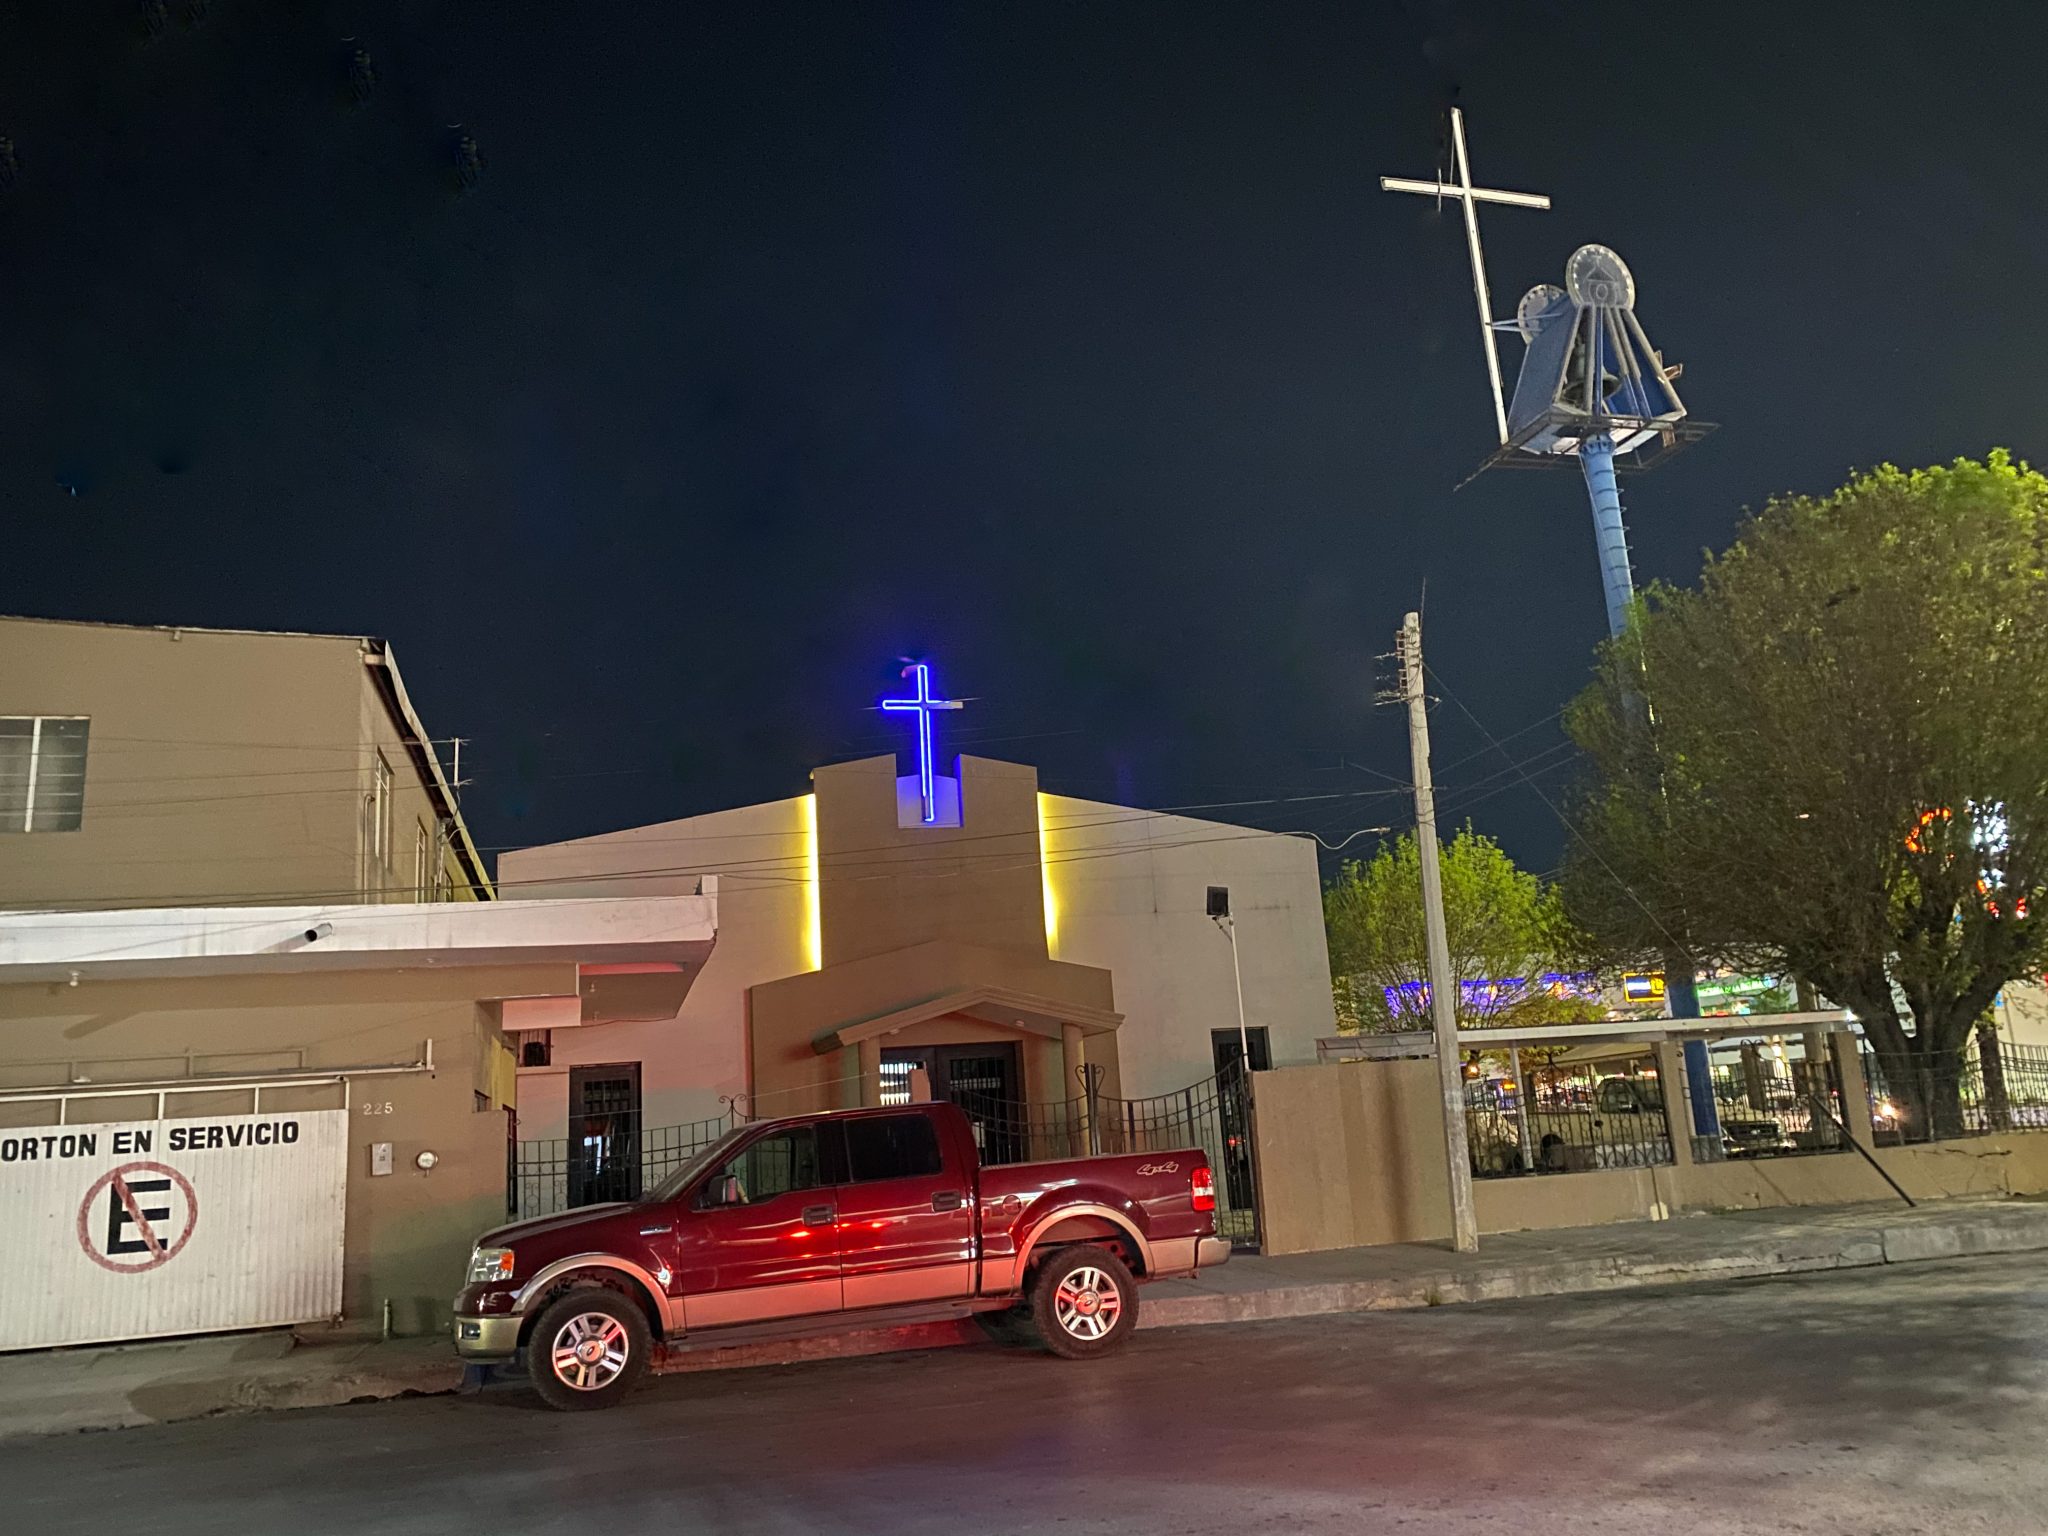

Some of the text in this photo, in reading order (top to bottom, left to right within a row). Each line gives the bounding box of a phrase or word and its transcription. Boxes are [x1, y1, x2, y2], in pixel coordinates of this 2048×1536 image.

[363, 1101, 393, 1116] 225
[112, 1130, 152, 1155] EN
[169, 1121, 299, 1151] SERVICIO
[106, 1178, 172, 1256] E
